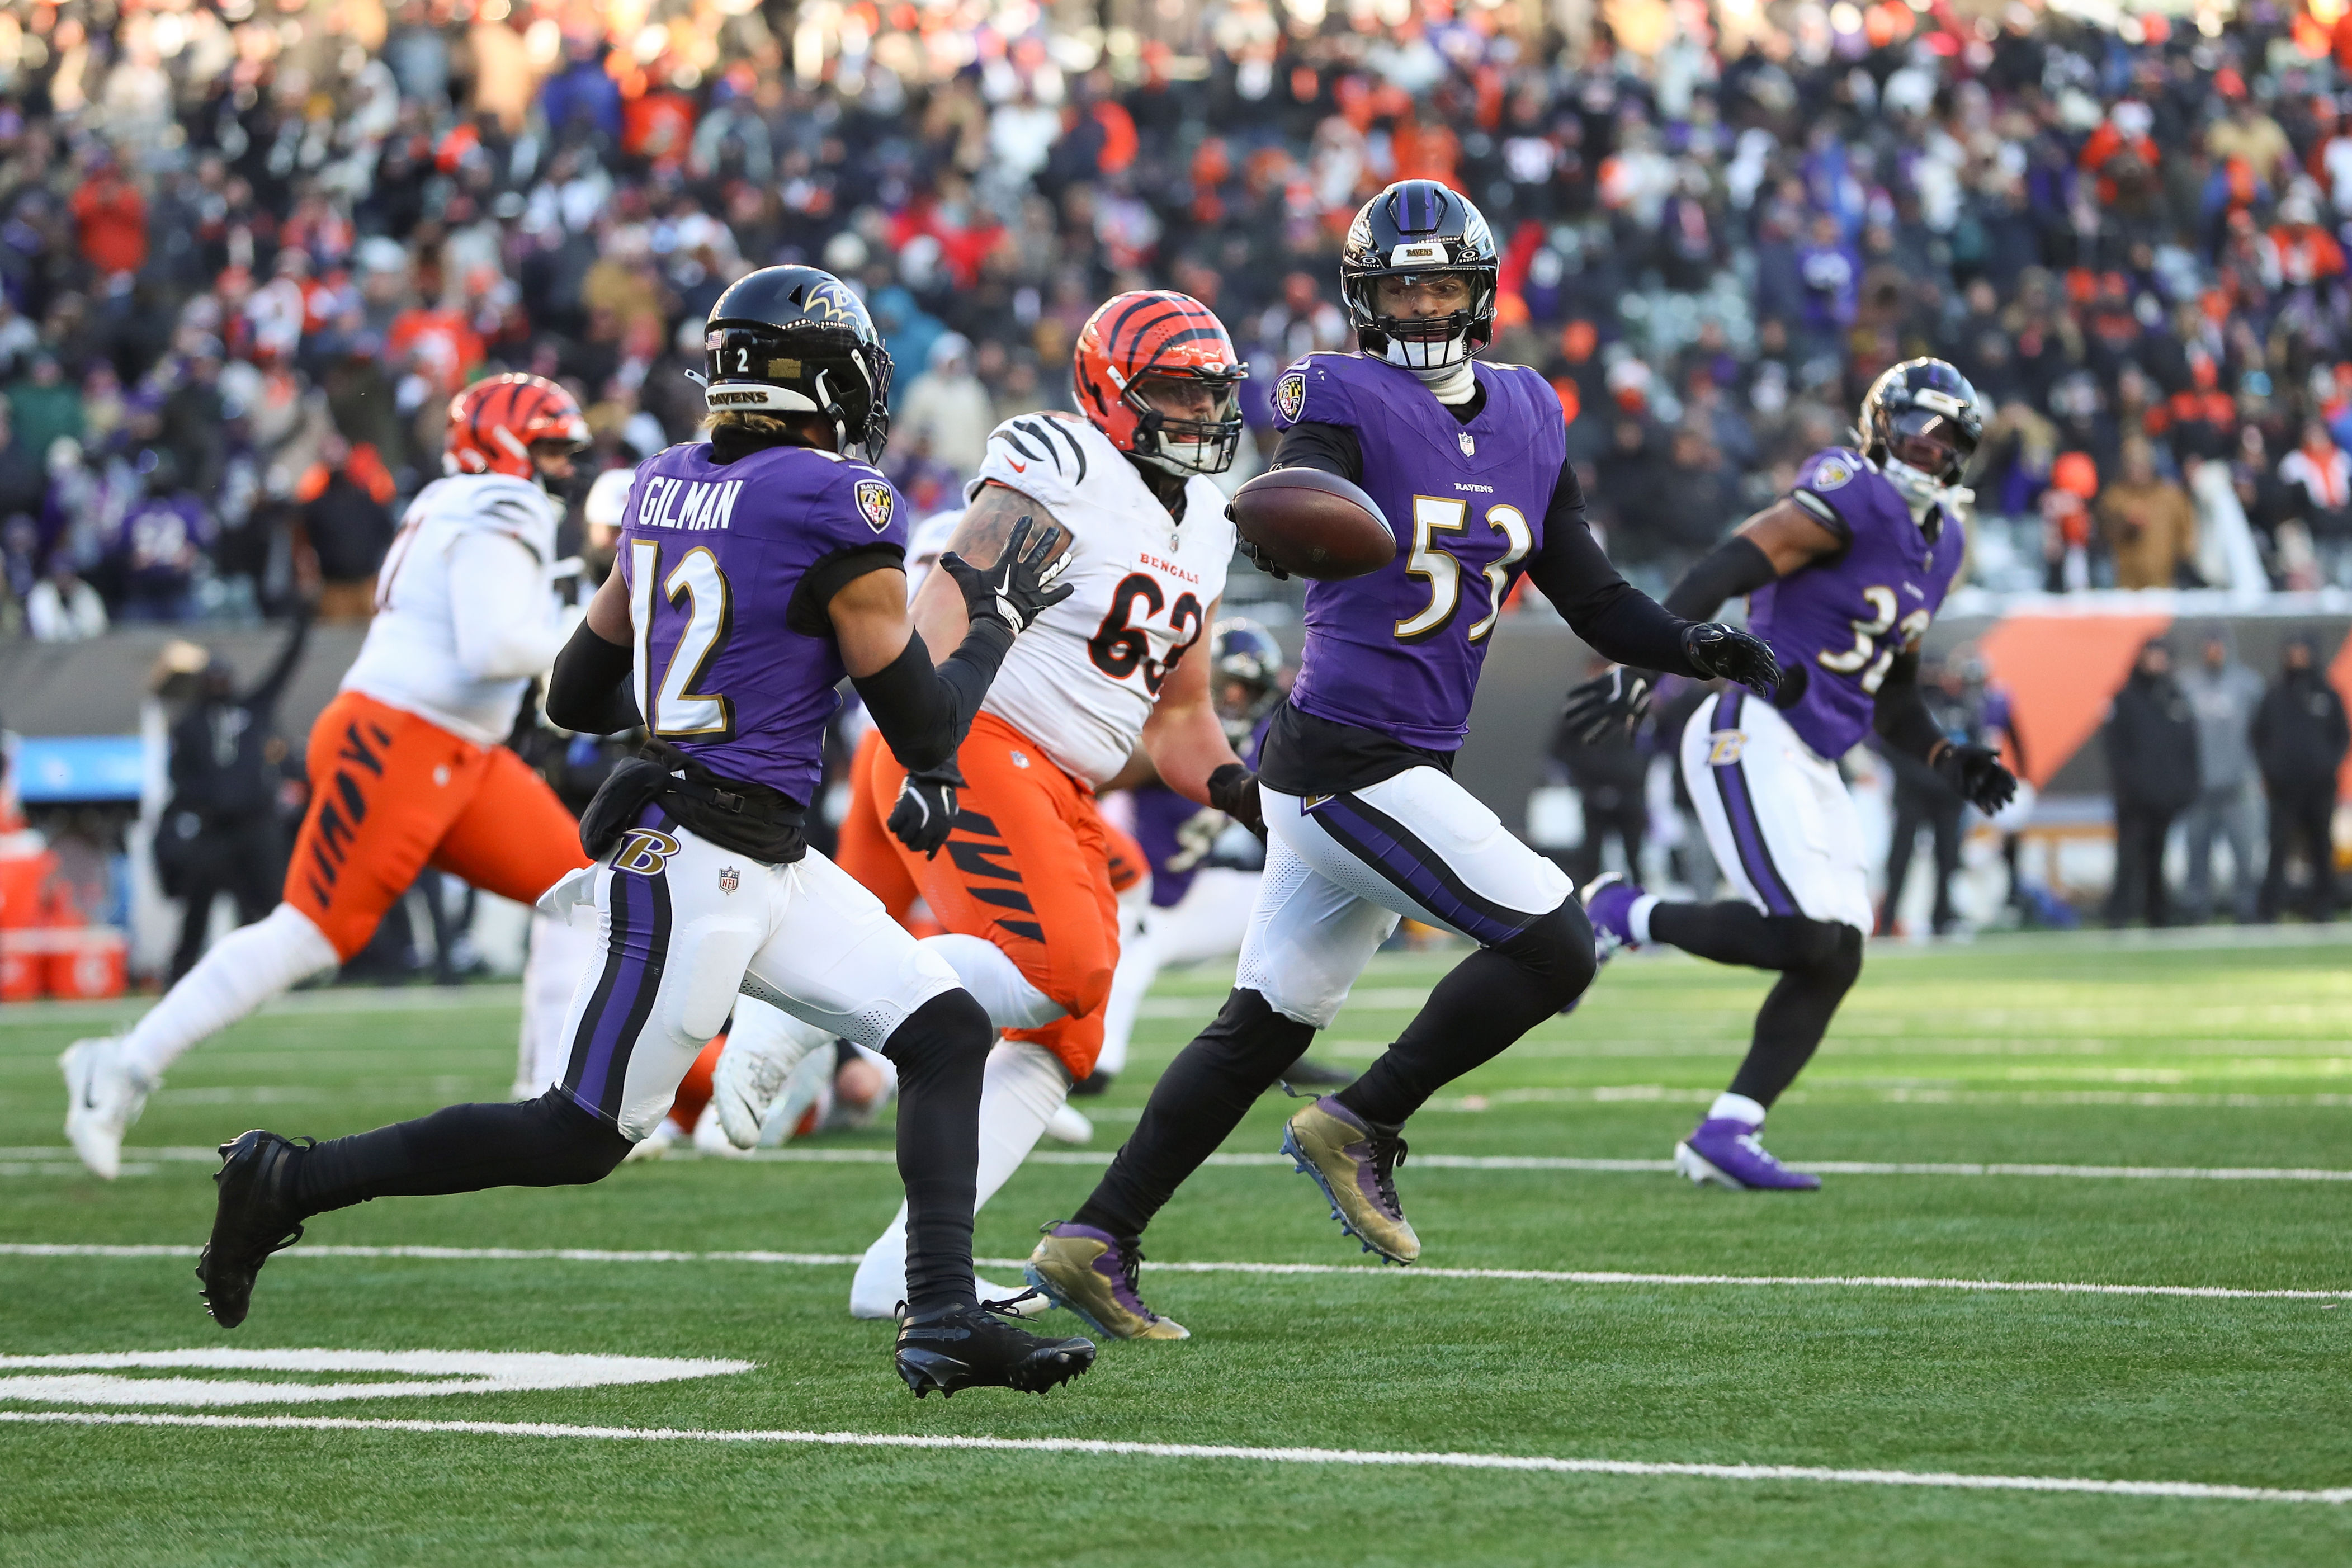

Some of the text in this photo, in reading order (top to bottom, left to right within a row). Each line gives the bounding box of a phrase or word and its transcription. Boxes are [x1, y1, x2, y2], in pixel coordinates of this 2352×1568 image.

[1406, 248, 1433, 257] RAVENS
[716, 347, 749, 374] 12
[707, 391, 769, 406] RAVENS
[859, 483, 889, 493] RAVENS
[1453, 483, 1494, 493] RAVENS
[639, 476, 744, 531] GILMAN
[1140, 552, 1199, 584] BENGALS
[1394, 494, 1533, 642] 53
[630, 538, 736, 743] 12
[610, 828, 681, 876] B
[722, 878, 736, 889] NFL
